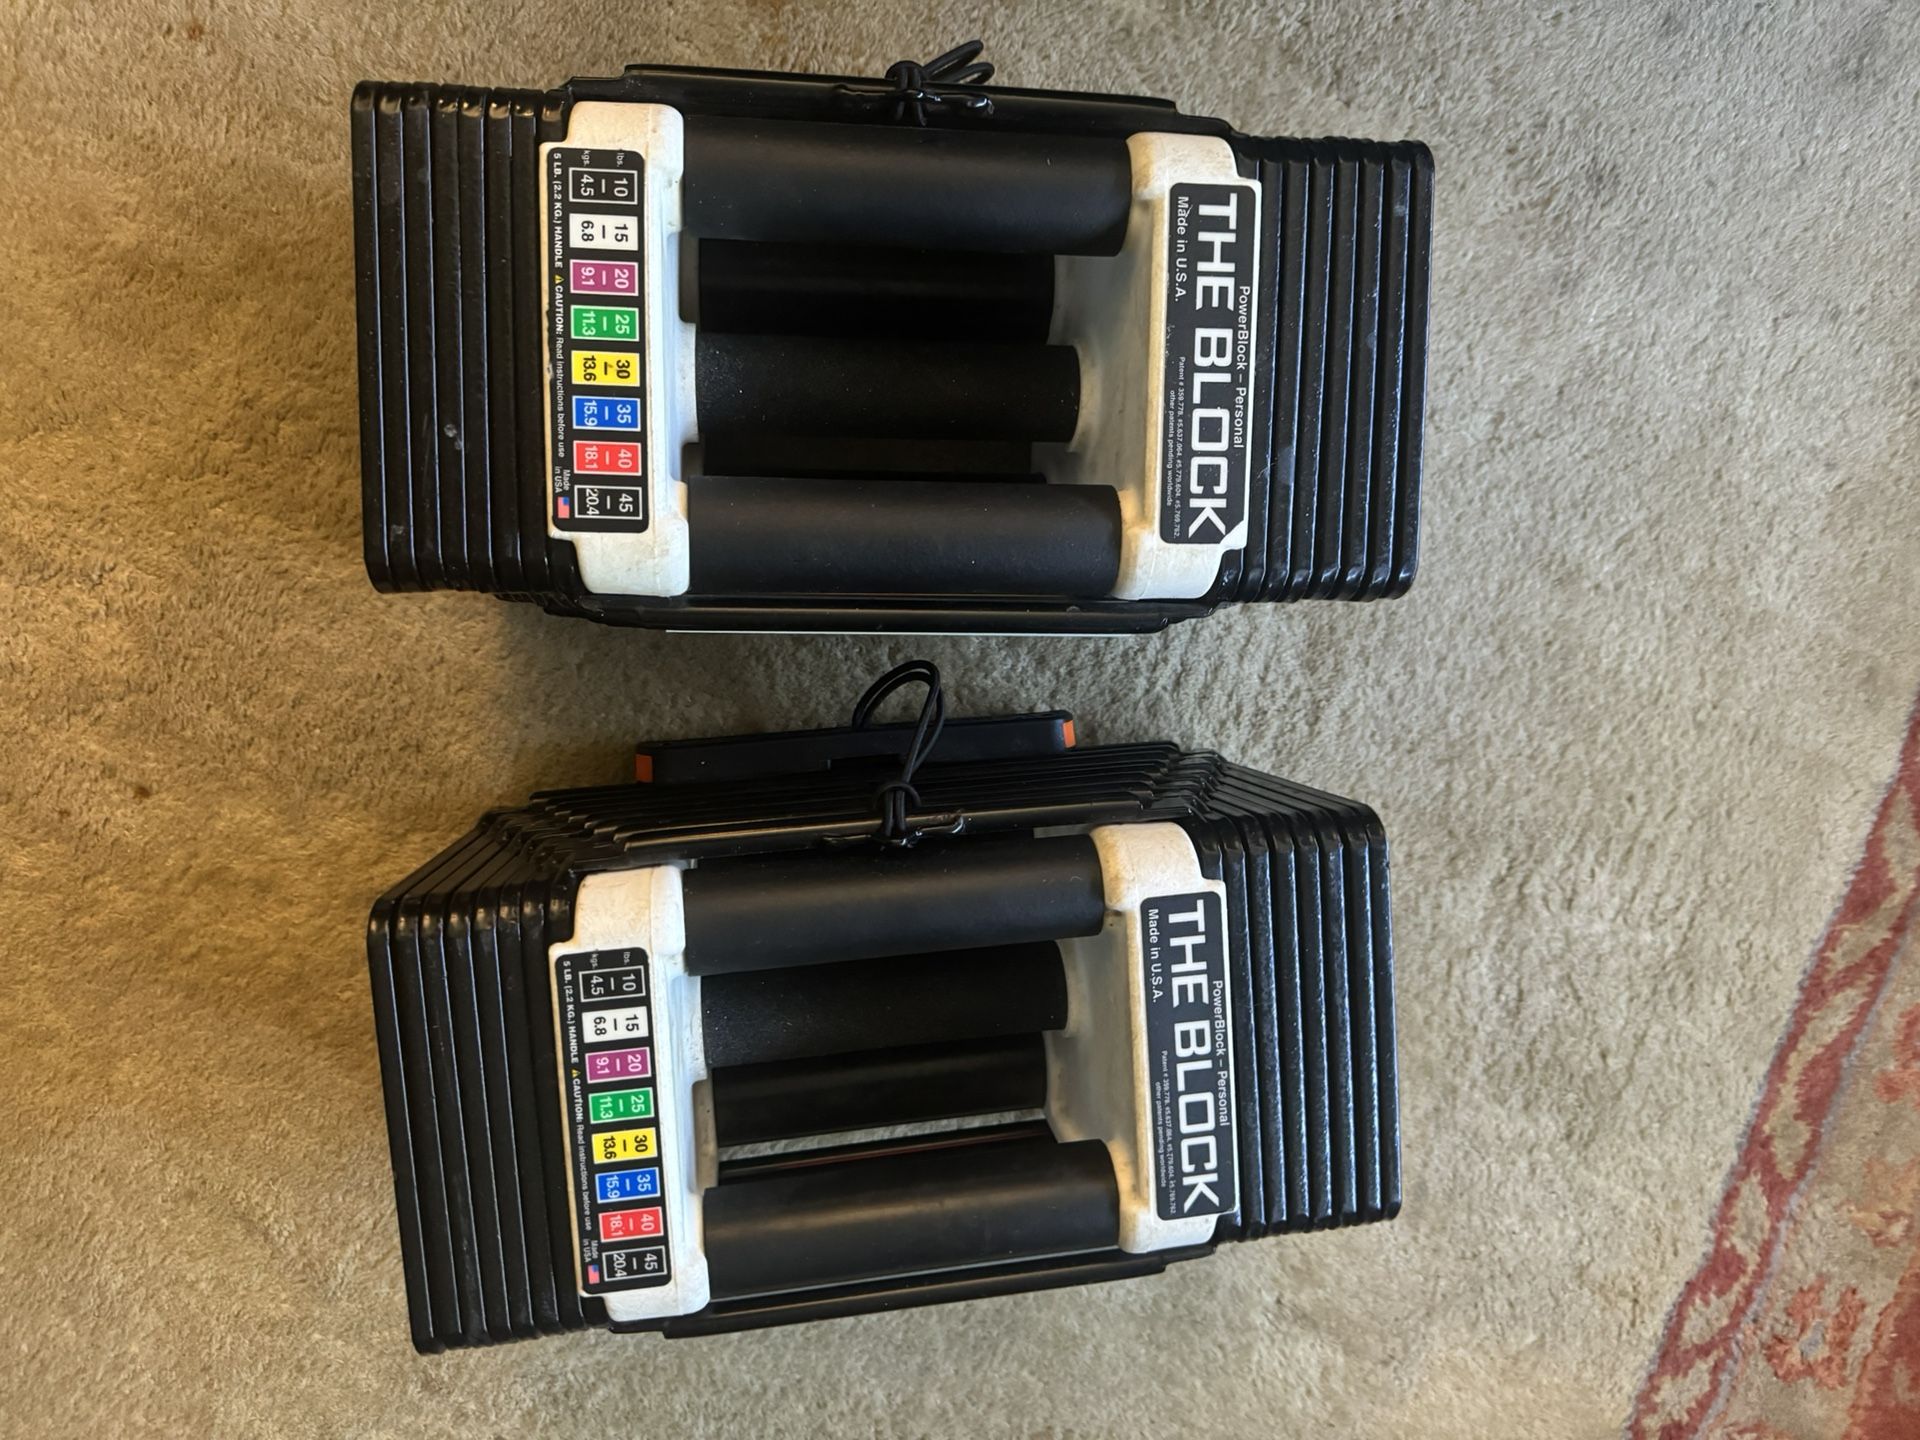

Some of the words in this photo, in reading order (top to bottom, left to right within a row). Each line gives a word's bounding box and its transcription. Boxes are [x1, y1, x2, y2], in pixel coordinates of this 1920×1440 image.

[582, 150, 590, 166] kgs.
[553, 181, 562, 200] (2.2
[581, 174, 594, 196] 4.5
[614, 178, 628, 197] 10
[553, 202, 562, 223] KG.)
[1177, 196, 1189, 235] Made
[582, 220, 594, 242] 6.8
[615, 224, 628, 242] 15
[554, 226, 562, 268] HANDLE
[1177, 240, 1187, 252] in
[1196, 193, 1237, 311] THE
[582, 267, 595, 286] 9.1
[615, 269, 629, 288] 20
[1175, 258, 1187, 301] U.S.A.
[555, 285, 564, 334] CAUTION:
[582, 311, 595, 336] 11.3
[616, 314, 629, 334] 25
[1237, 286, 1250, 370] PowerBlock
[556, 337, 564, 359] Read
[583, 355, 596, 381] 13.6
[616, 360, 630, 379] 30
[557, 361, 565, 411] instructions
[584, 400, 597, 426] 15.9
[617, 404, 631, 423] 35
[1234, 387, 1246, 448] Personal
[558, 413, 566, 440] before
[1188, 328, 1233, 538] BLOCK
[585, 445, 598, 469] 18.1
[618, 449, 632, 468] 40
[586, 488, 599, 515] 20.4
[619, 493, 633, 512] 45
[1148, 909, 1159, 943] Made
[1150, 948, 1160, 959] in
[1168, 900, 1209, 1008] THE
[590, 976, 604, 995] 4.5
[622, 974, 636, 991] 10
[1152, 964, 1163, 1002] U.S.A.
[594, 1017, 606, 1036] 6.8
[626, 1014, 639, 1031] 15
[1213, 981, 1226, 1056] PowerBlock
[568, 1026, 579, 1063] HANDLE
[596, 1057, 609, 1074] 9.1
[628, 1054, 641, 1072] 20
[573, 1079, 583, 1122] CAUTION:
[600, 1096, 613, 1118] 11.3
[631, 1095, 644, 1112] 25
[1217, 1071, 1230, 1126] Personal
[1174, 1020, 1219, 1214] BLOCK
[577, 1125, 585, 1144] Read
[634, 1135, 648, 1152] 30
[603, 1136, 616, 1159] 13.6
[578, 1146, 589, 1190] instructions
[606, 1175, 620, 1198] 15.9
[637, 1174, 651, 1191] 35
[582, 1192, 591, 1215] before
[610, 1215, 623, 1236] 18.1
[641, 1214, 654, 1231] 40
[614, 1253, 626, 1277] 20.4
[644, 1254, 658, 1270] 45
